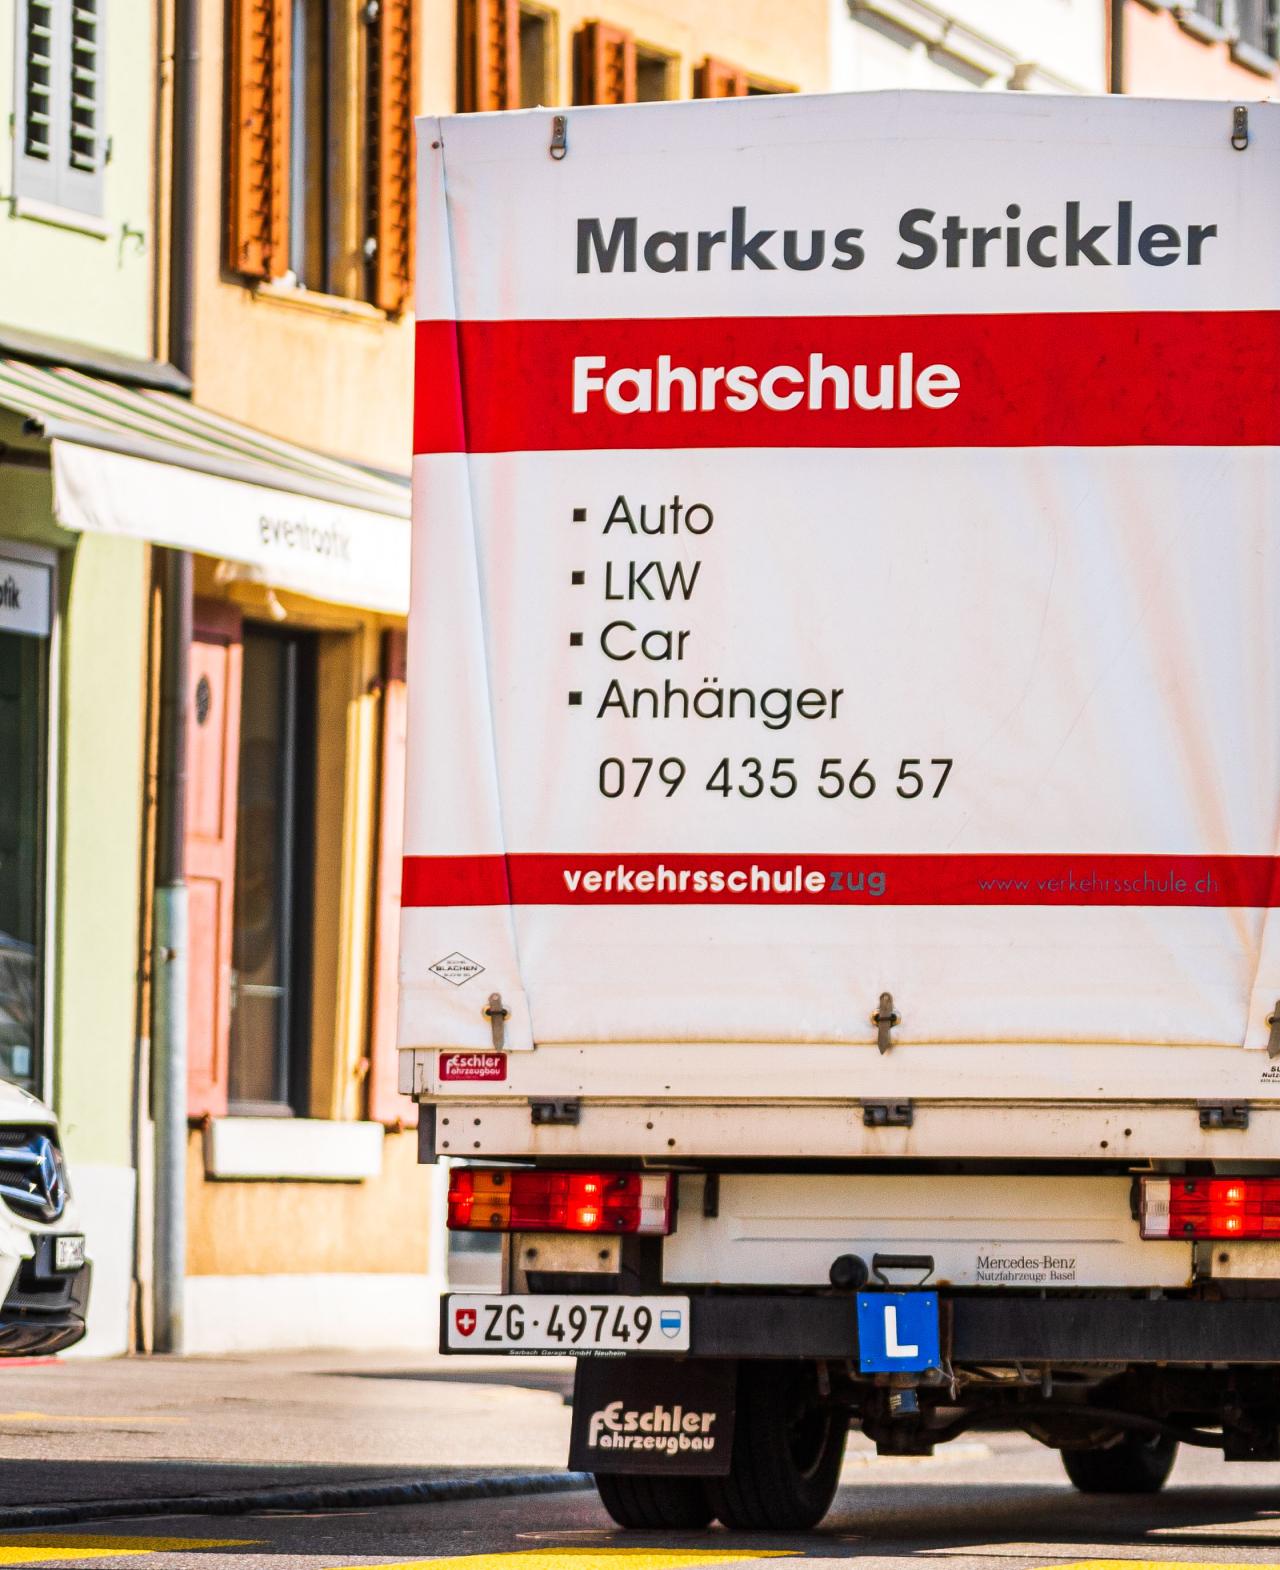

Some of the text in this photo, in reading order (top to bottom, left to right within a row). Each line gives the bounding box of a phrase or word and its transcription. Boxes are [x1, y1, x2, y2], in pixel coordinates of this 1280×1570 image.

[576, 200, 1218, 275] Markus Strickler
[571, 351, 961, 415] Fahrschule
[602, 494, 714, 535] Auto
[604, 560, 702, 601] LKW
[600, 620, 691, 662] Car
[596, 676, 845, 731] Anhänger
[598, 757, 954, 800] 079 435 56 57
[976, 1256, 1076, 1270] Mercedes-Benz
[976, 1270, 1076, 1282] Nutzfahrzeuge Basel
[884, 1305, 919, 1358] L
[603, 1401, 716, 1432] Eschler
